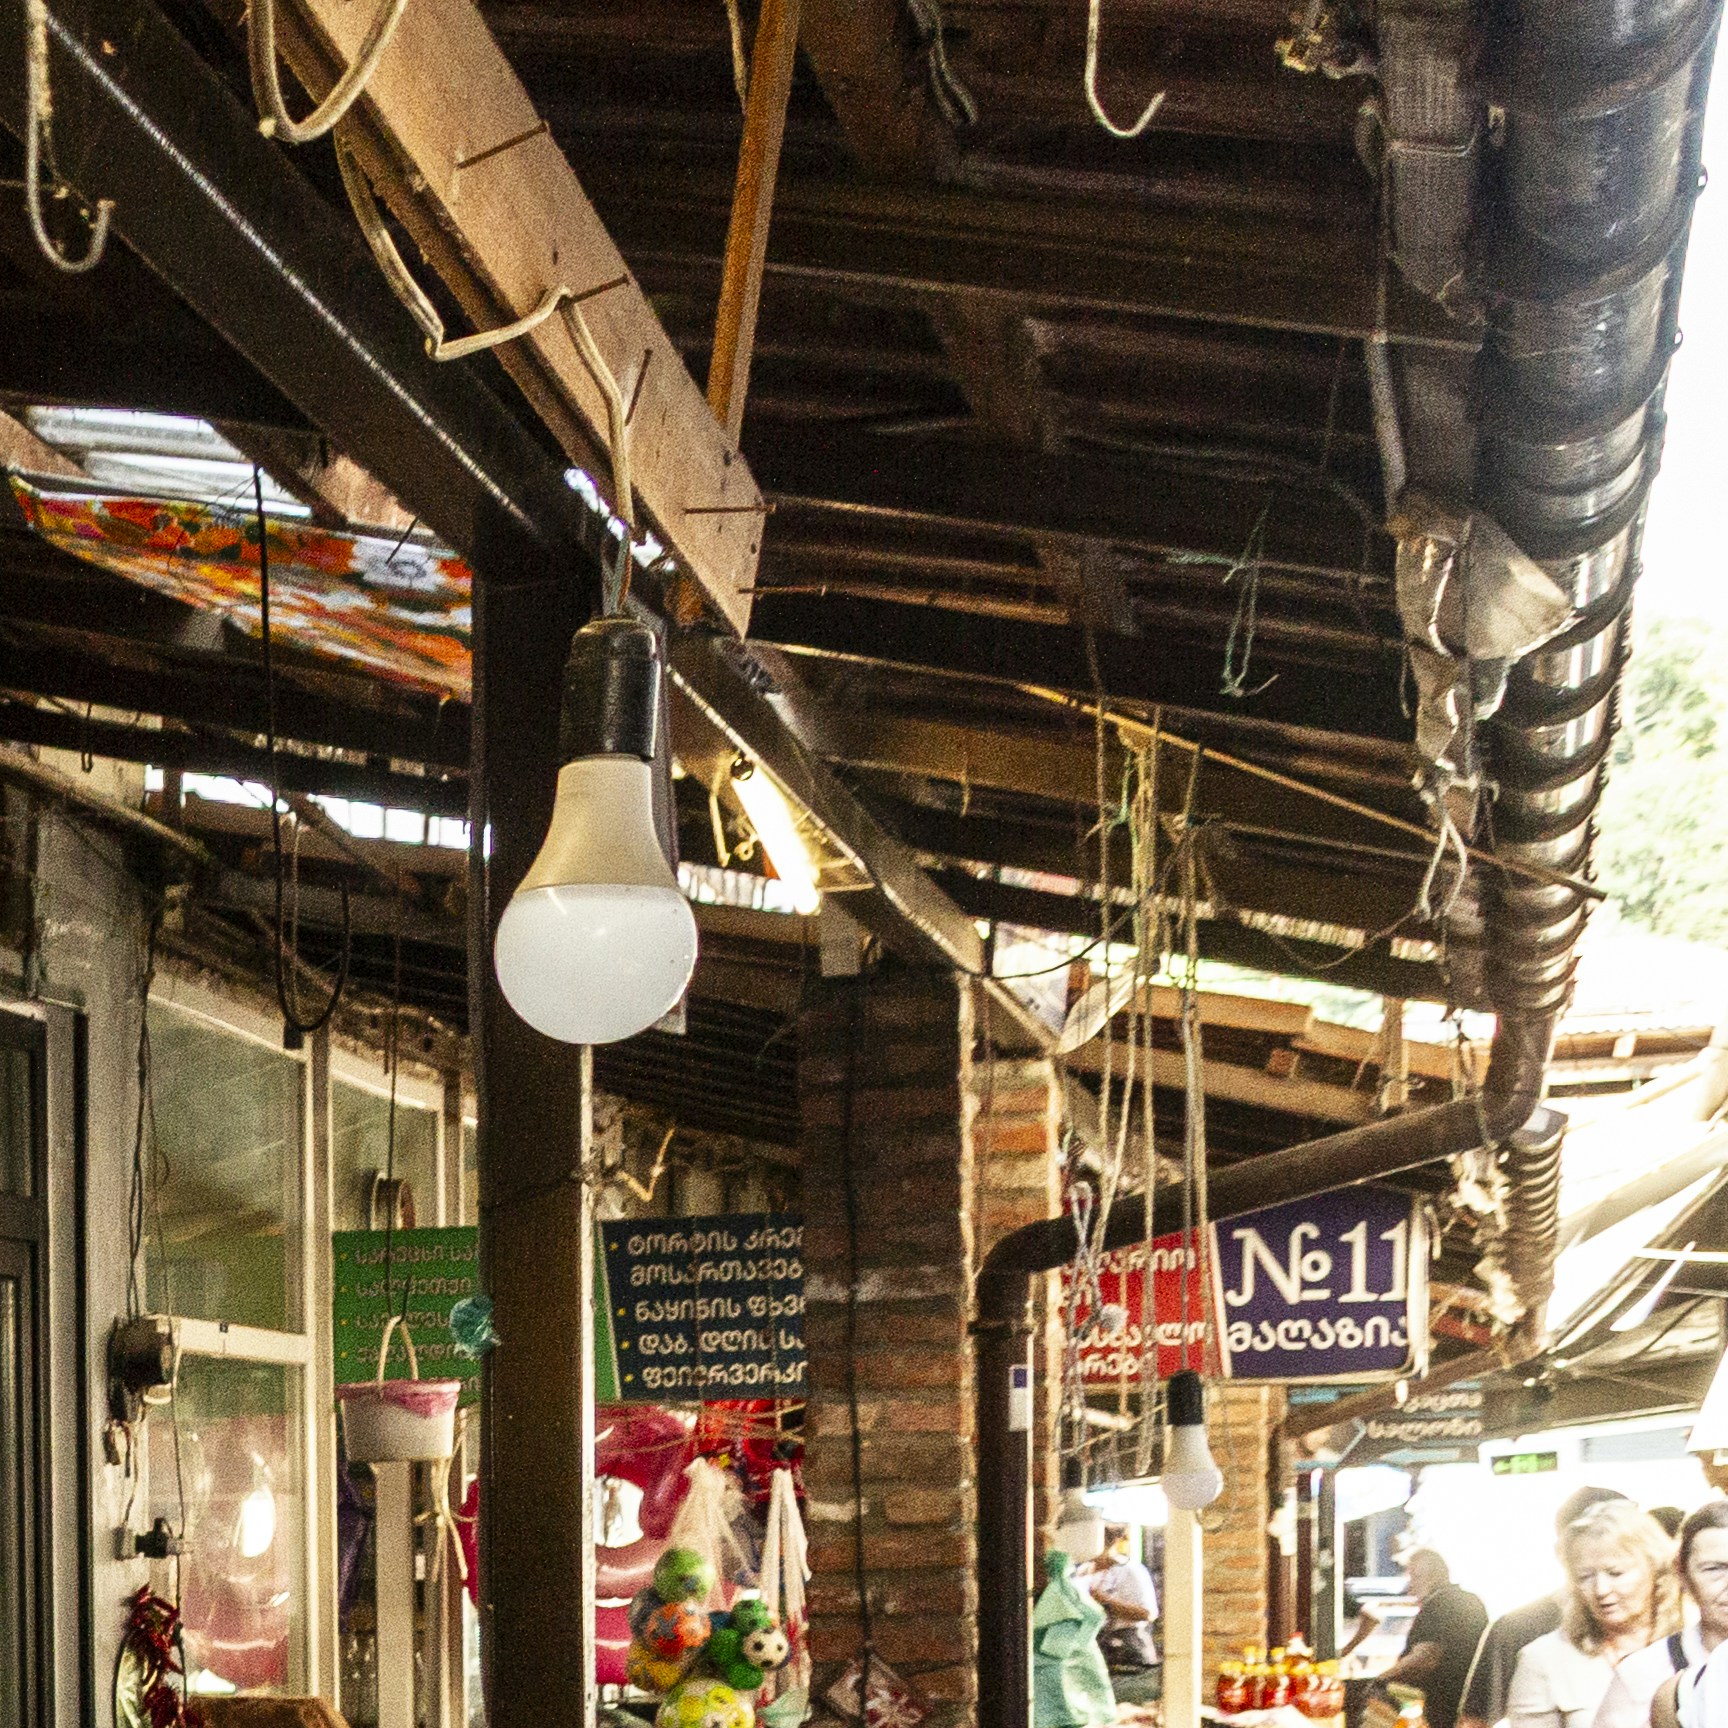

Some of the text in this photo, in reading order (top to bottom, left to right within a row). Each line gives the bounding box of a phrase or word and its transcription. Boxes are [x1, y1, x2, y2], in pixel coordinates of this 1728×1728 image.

[627, 1226, 804, 1257] ტორტის კრე
[630, 1258, 804, 1288] მოსართავებ
[634, 1293, 806, 1323] ნაყინის ფხვ
